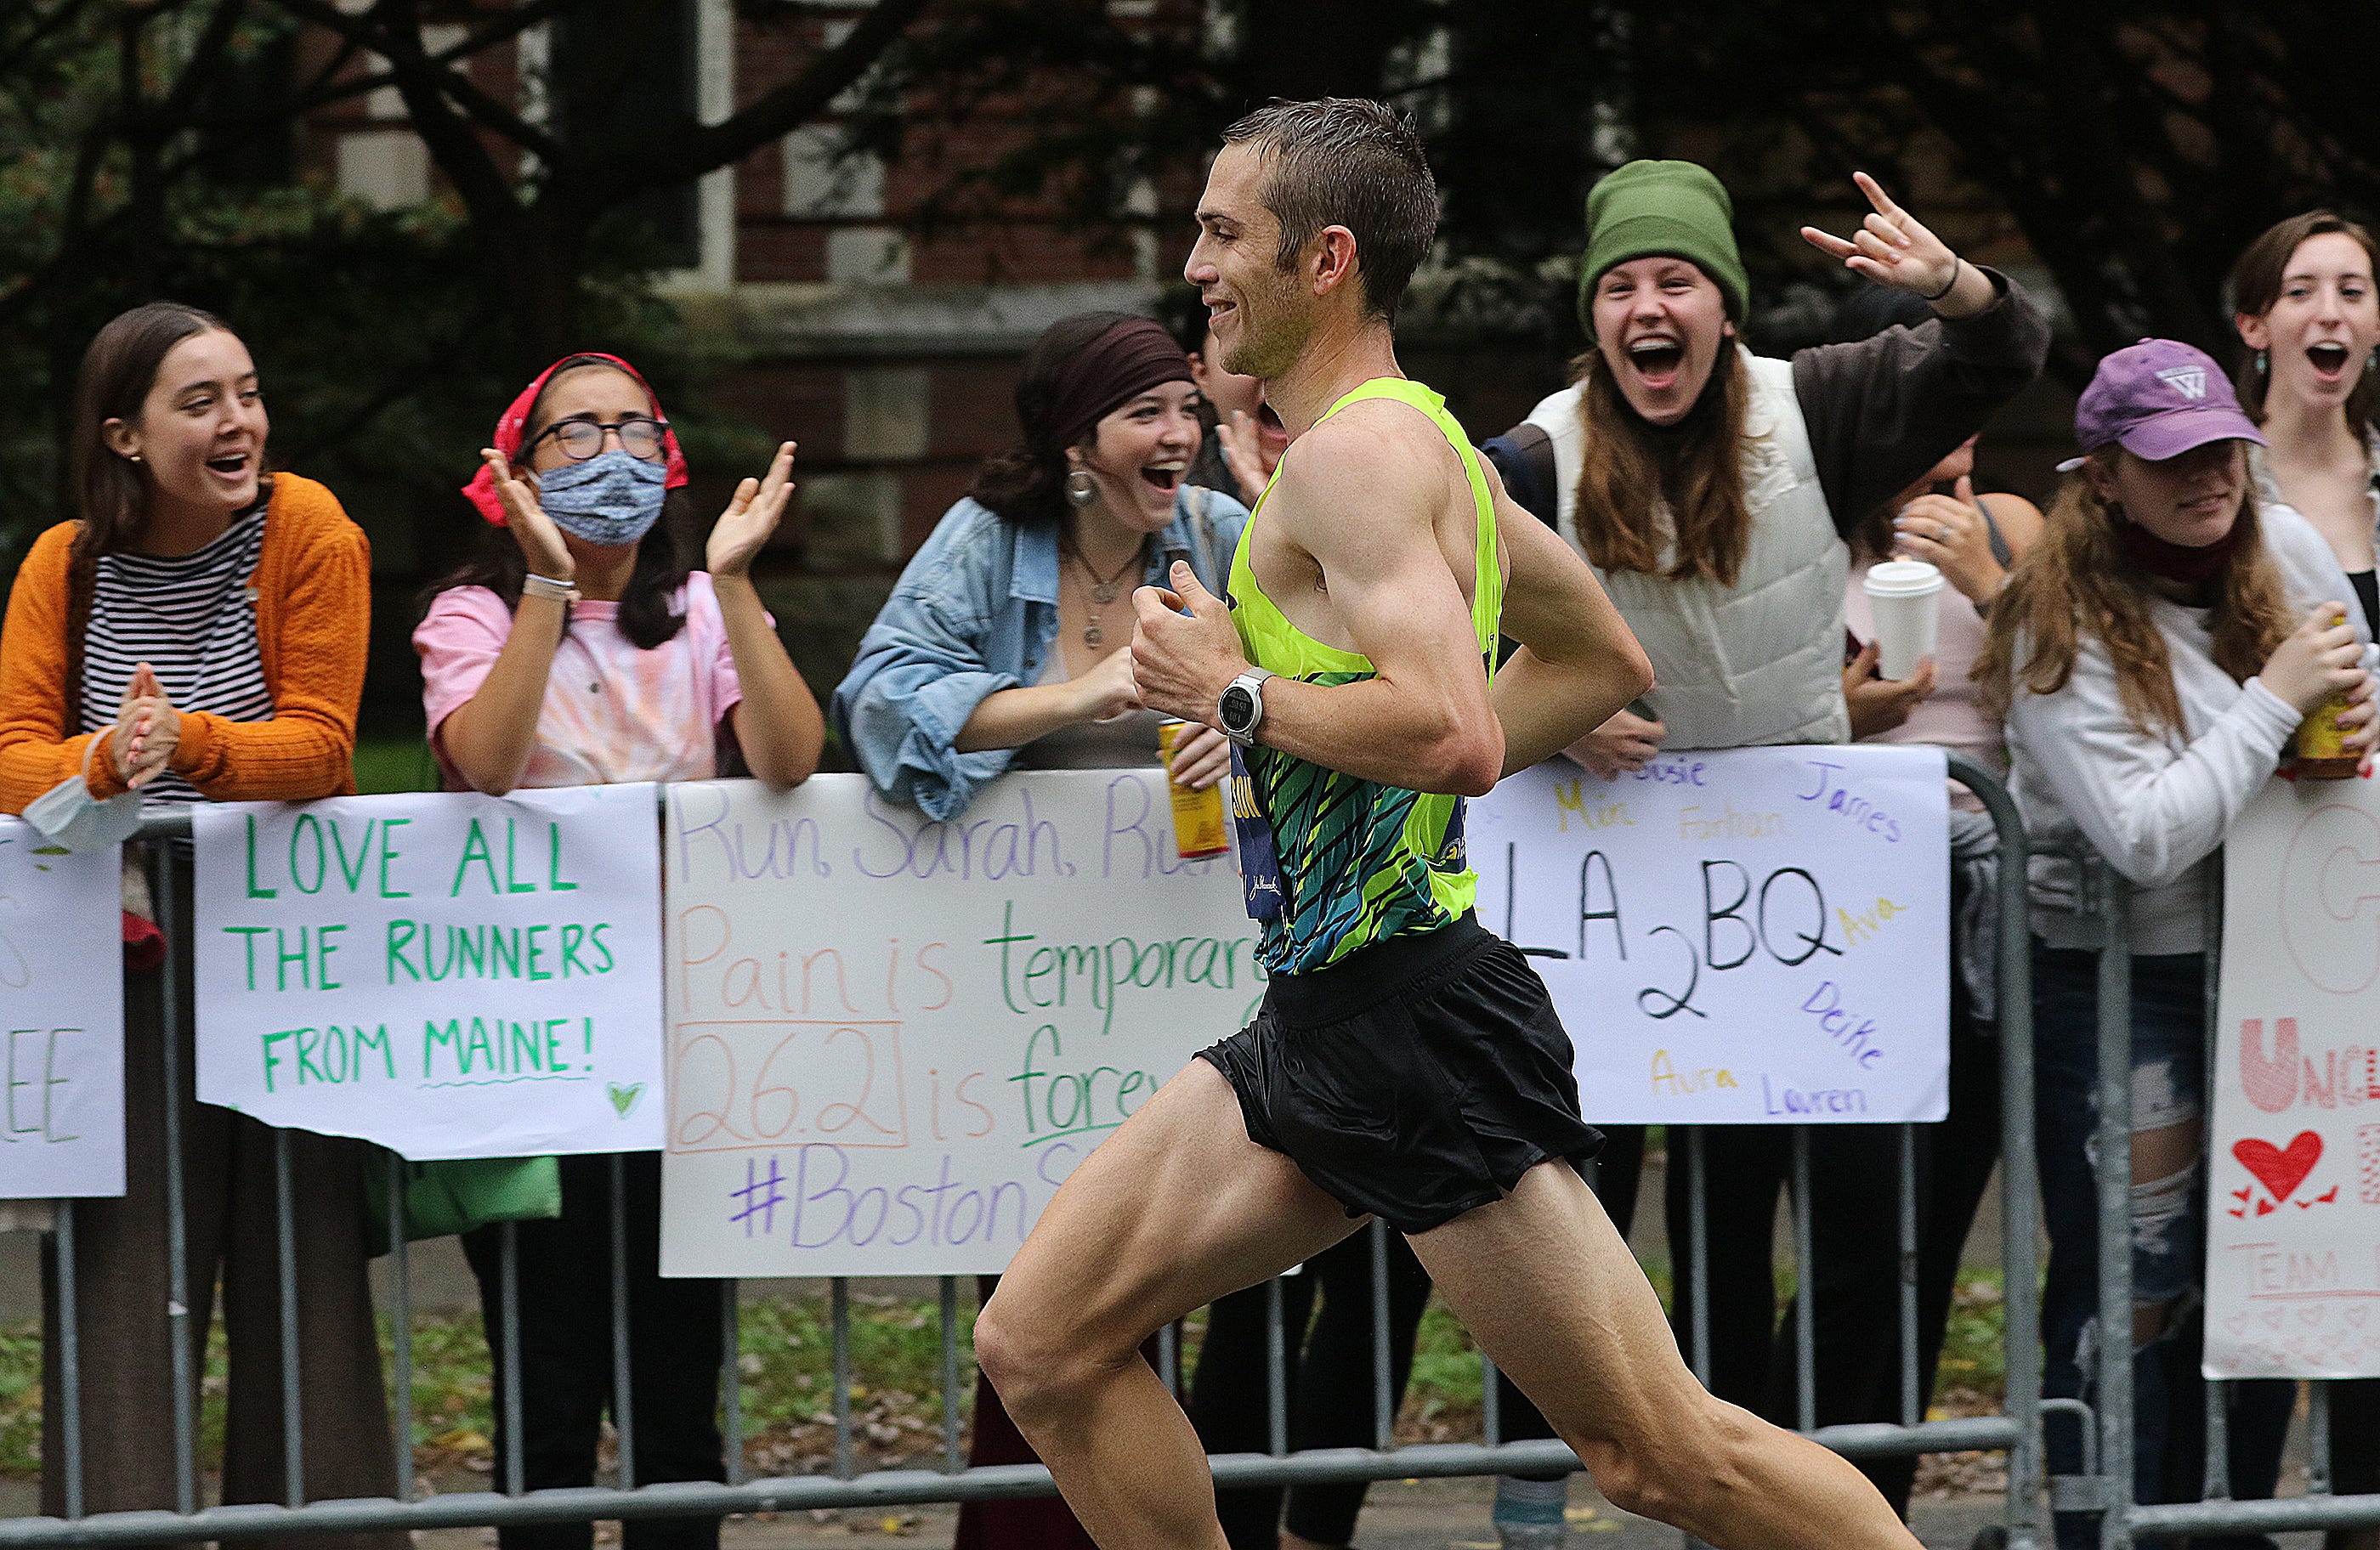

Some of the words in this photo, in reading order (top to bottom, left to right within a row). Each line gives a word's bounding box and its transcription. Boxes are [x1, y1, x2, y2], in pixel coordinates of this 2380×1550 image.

[246, 813, 413, 899] LOVE
[450, 817, 579, 898] ALL
[222, 925, 348, 991] THE
[386, 919, 615, 985] RUNNERS
[678, 904, 861, 1014] Pain
[887, 937, 953, 1011] is
[0, 1027, 84, 1145] EE
[262, 1022, 396, 1093] FROM
[424, 1016, 594, 1075] MAINE!
[678, 1027, 898, 1145] 26.2
[929, 1068, 997, 1141] is
[1007, 1023, 1159, 1134] fore
